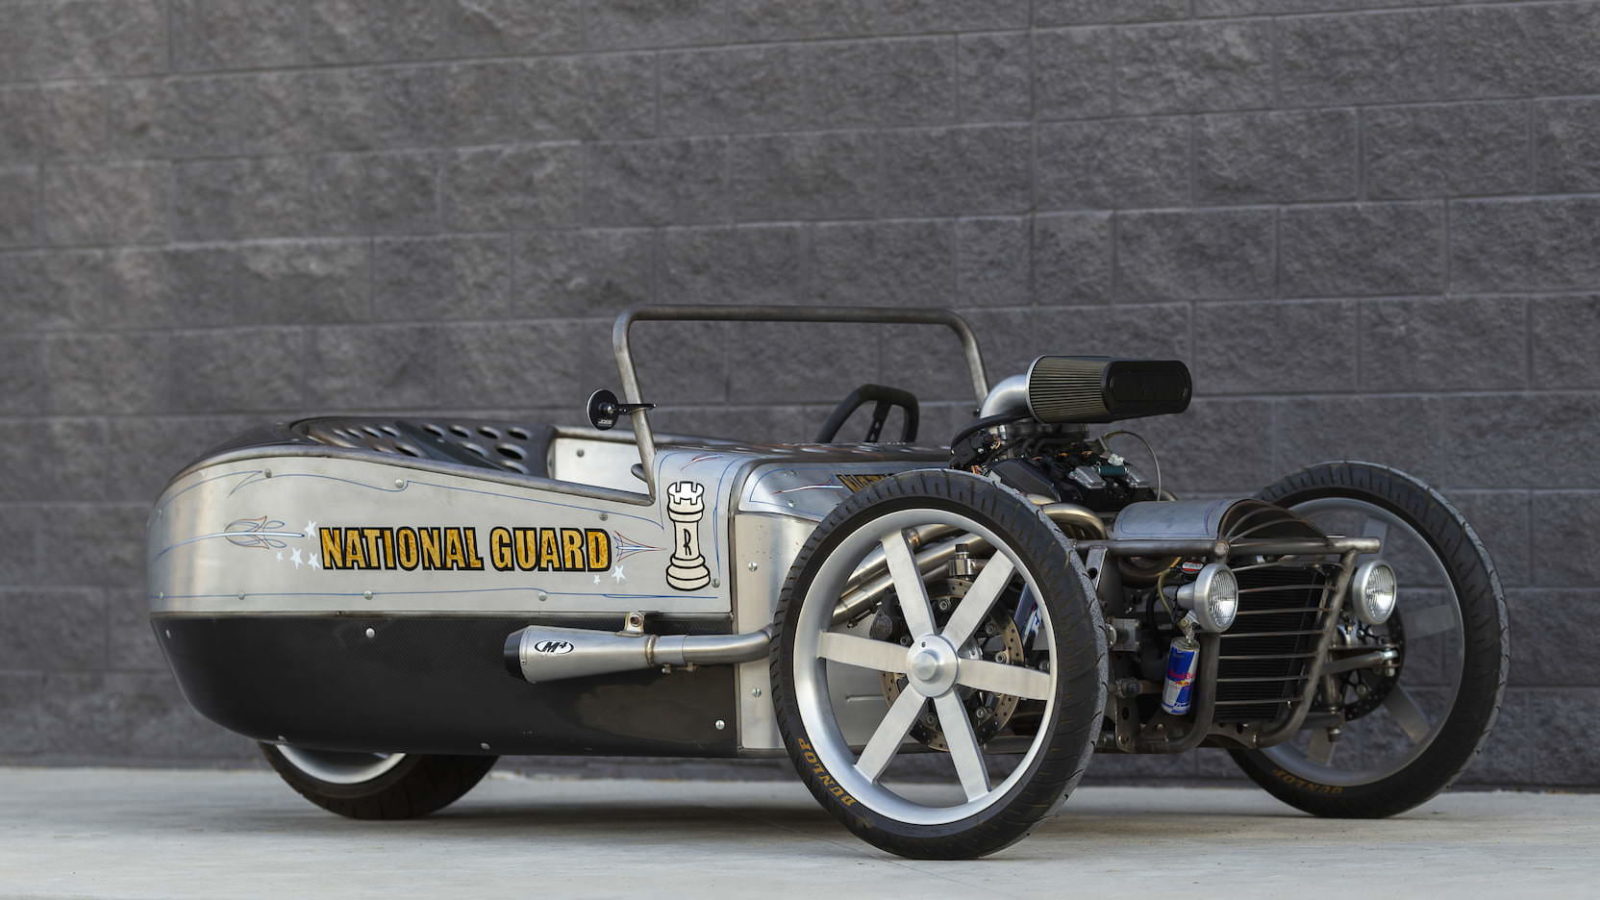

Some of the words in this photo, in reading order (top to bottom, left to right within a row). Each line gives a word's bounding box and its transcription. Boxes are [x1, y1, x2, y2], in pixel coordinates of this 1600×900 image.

[319, 526, 485, 571] NATIONAL
[489, 526, 612, 572] GUARD
[683, 528, 692, 556] R
[541, 641, 568, 653] M4
[797, 738, 857, 807] DUNLOP
